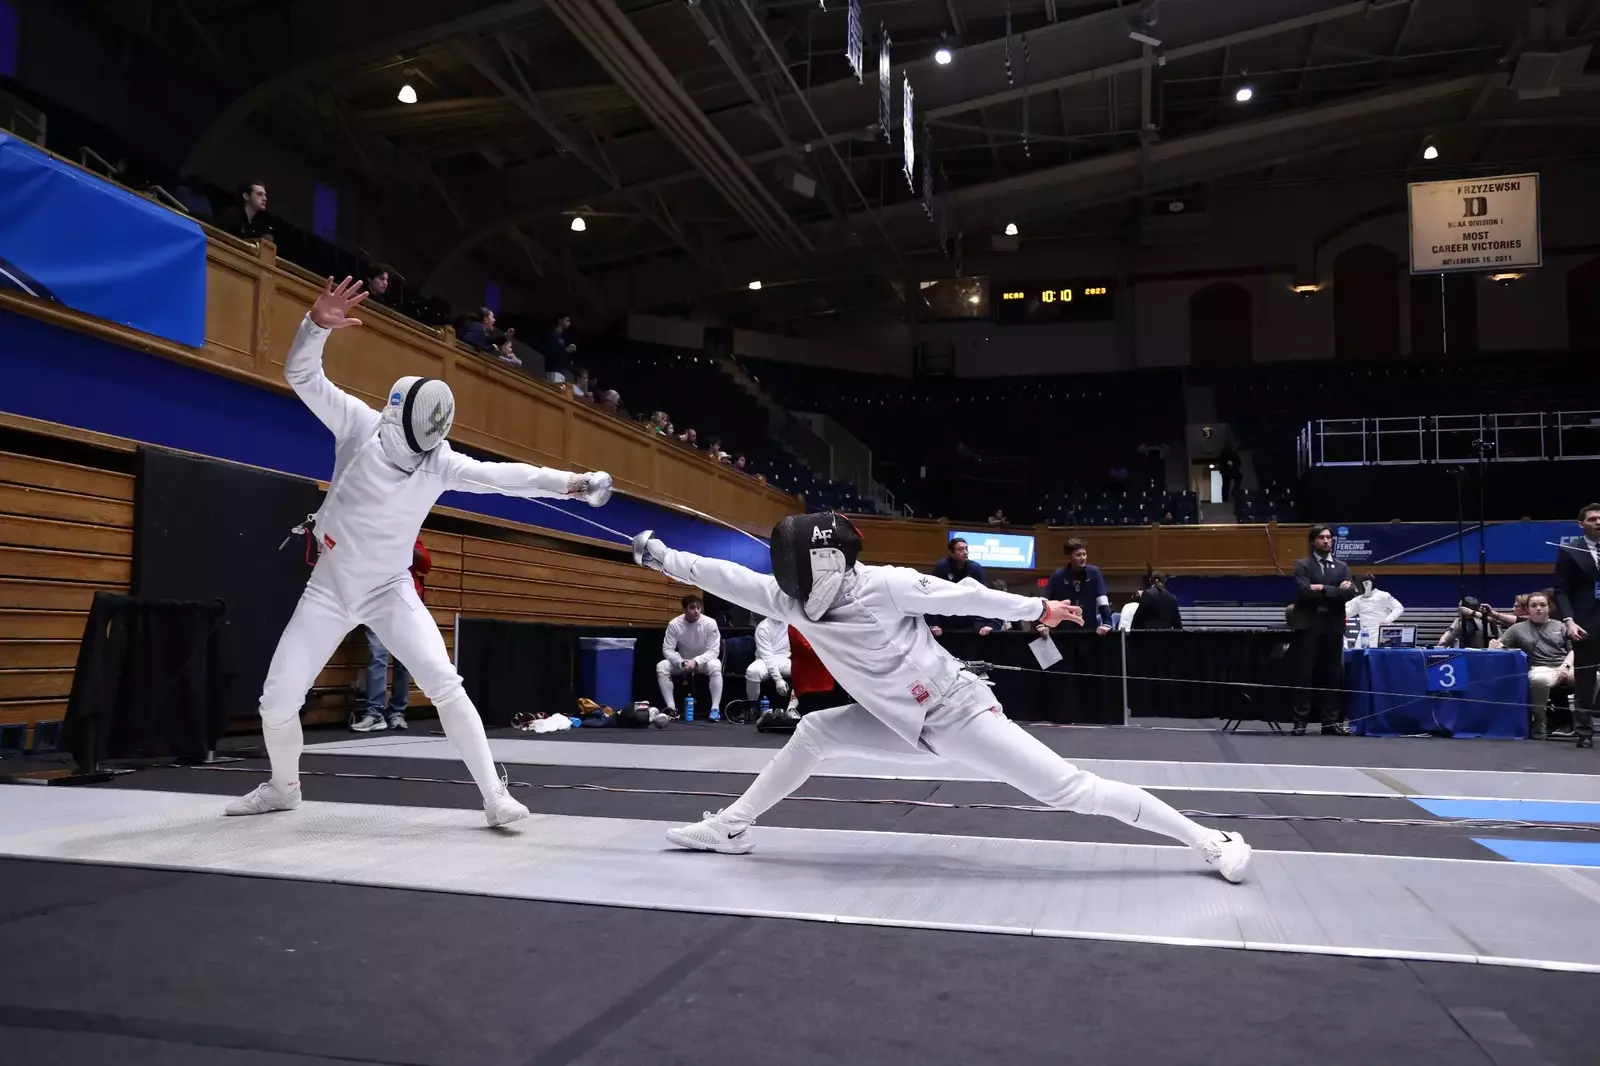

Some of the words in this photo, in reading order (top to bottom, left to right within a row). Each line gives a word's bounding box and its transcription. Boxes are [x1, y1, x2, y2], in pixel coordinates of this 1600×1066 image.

[1468, 218, 1498, 227] DIVISION
[1462, 231, 1490, 241] MOST
[1432, 243, 1469, 254] CAREER
[1471, 240, 1522, 251] VICTORIES
[1442, 257, 1480, 266] NOVEMBER
[811, 525, 833, 546] AF
[1439, 664, 1456, 687] 3
